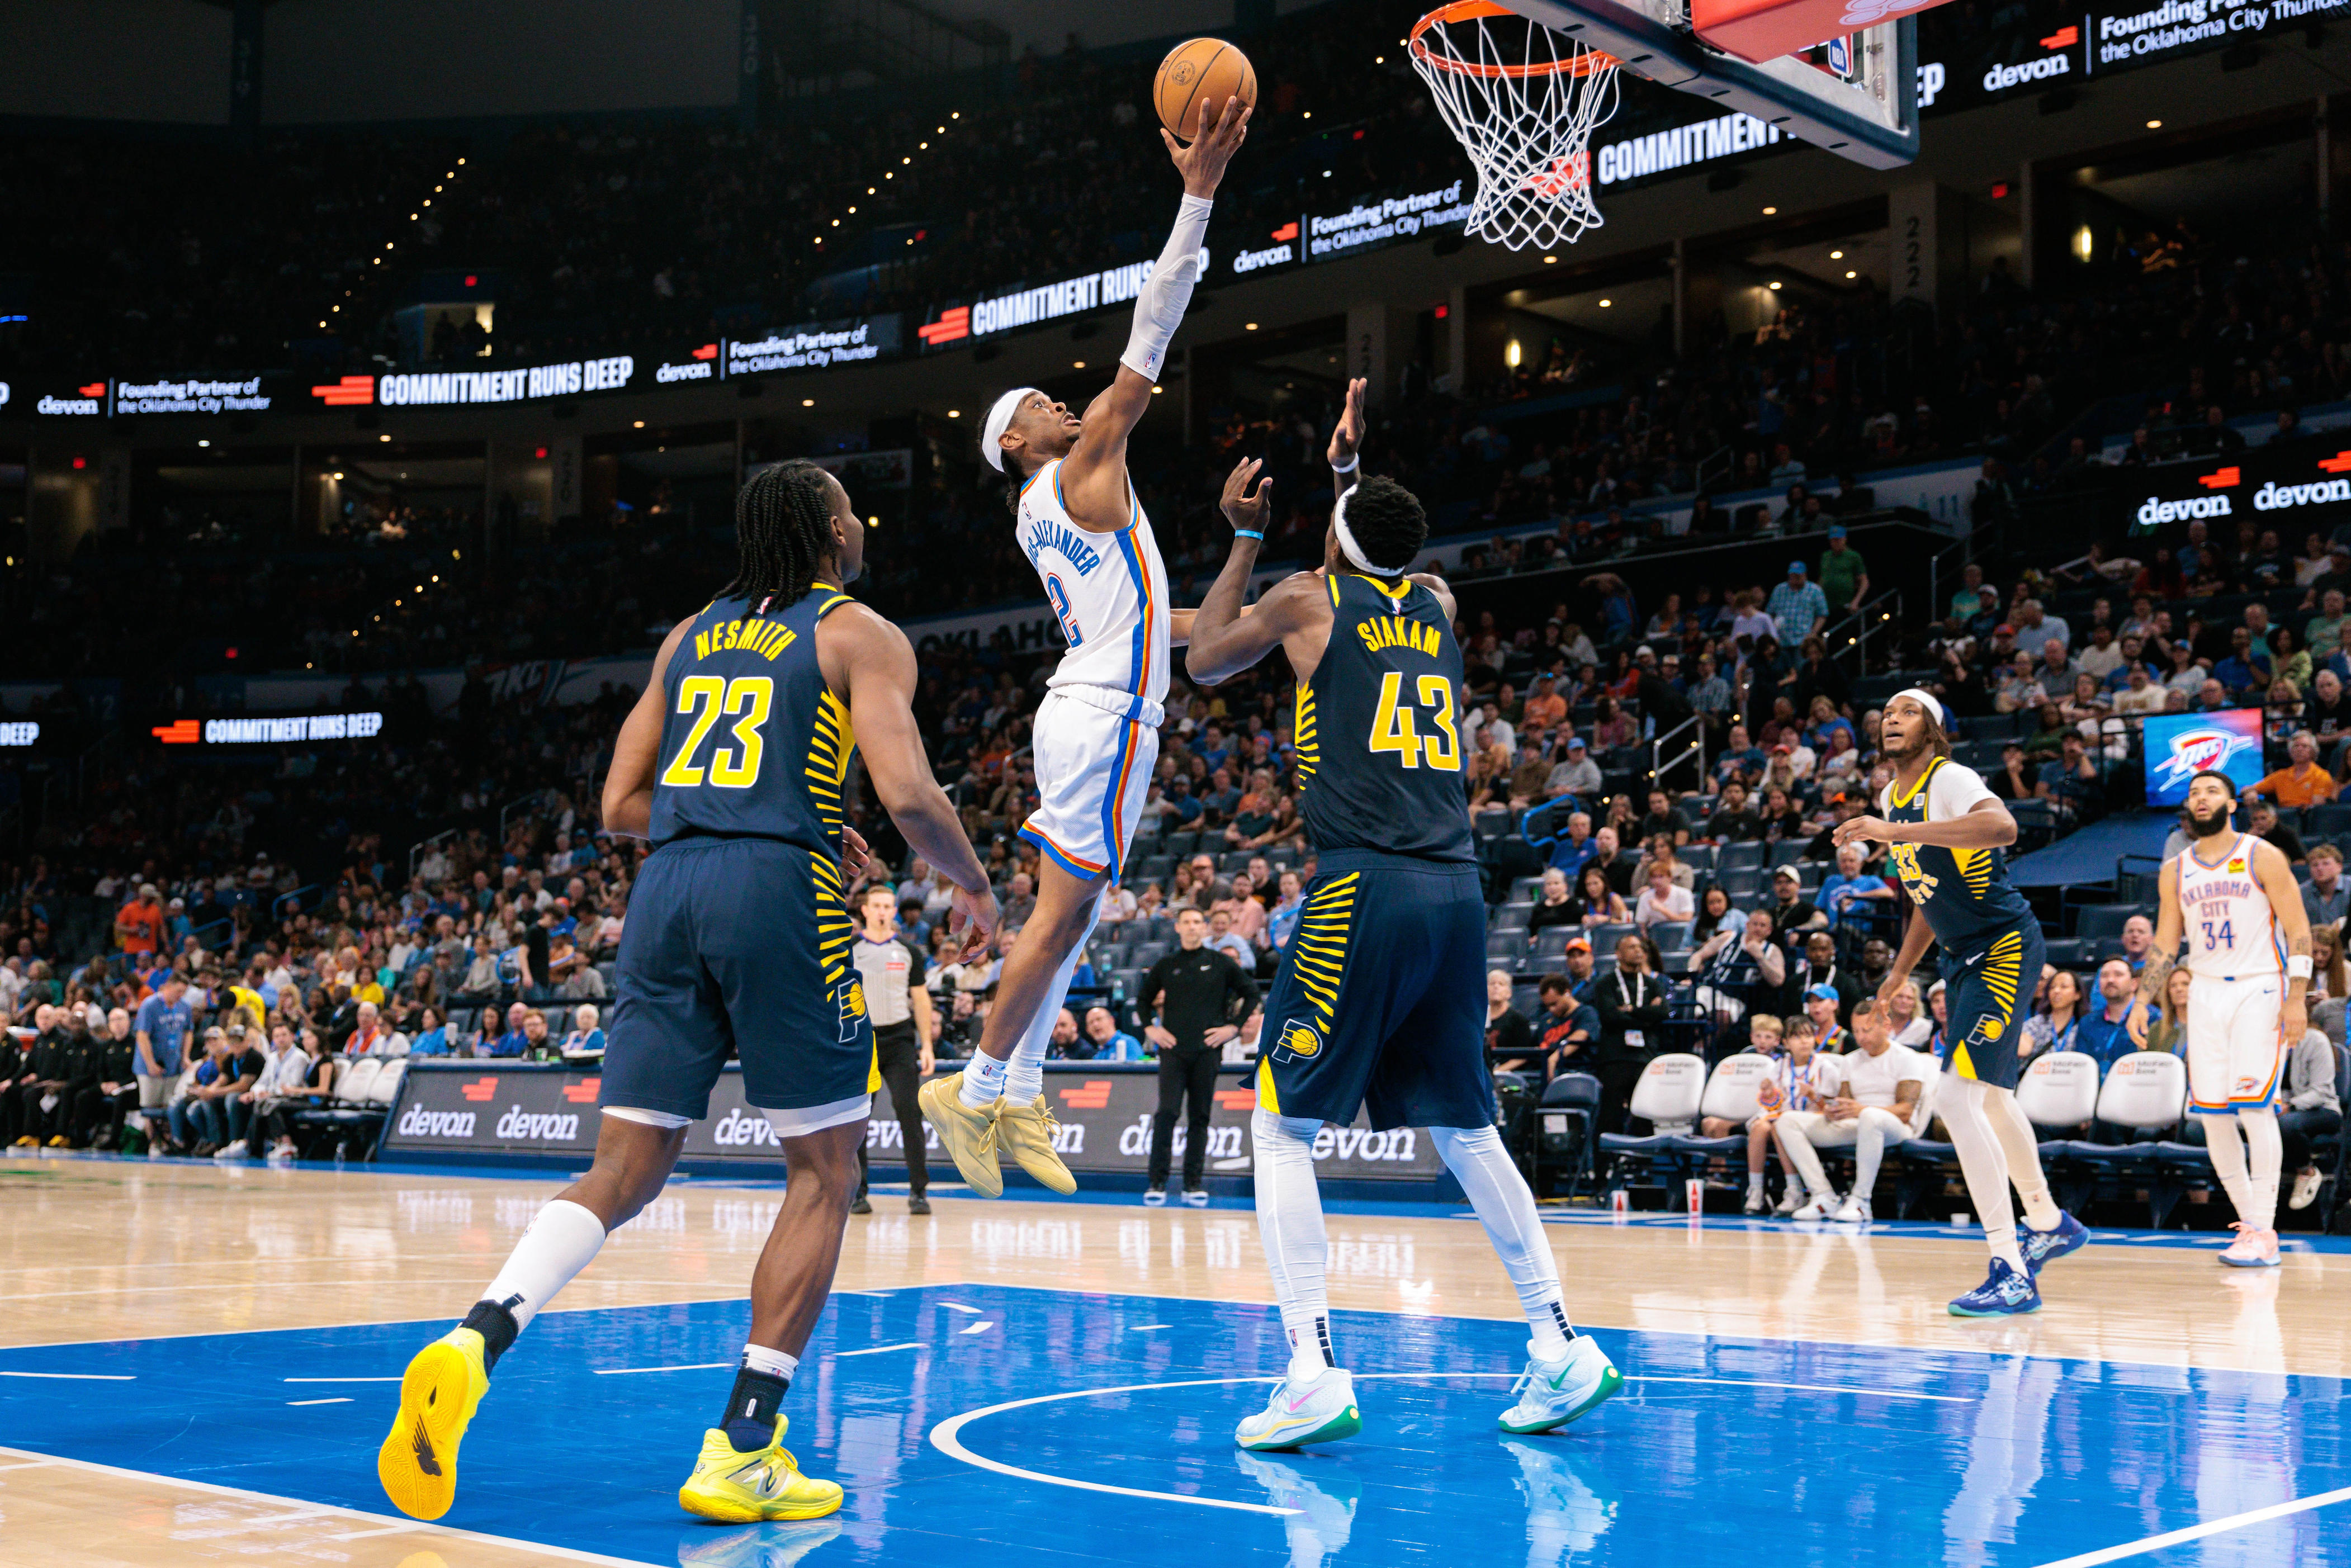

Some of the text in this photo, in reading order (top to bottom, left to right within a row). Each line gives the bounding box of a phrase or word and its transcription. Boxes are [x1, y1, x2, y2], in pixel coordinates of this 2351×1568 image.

[2099, 41, 2131, 63] the
[2132, 18, 2226, 54] Oklahoma
[2229, 7, 2269, 31] City
[2100, 0, 2208, 40] Founding
[1832, 46, 1844, 67] NBA
[1984, 53, 2070, 92] devon
[1311, 179, 1463, 236] Founding Partner of
[1311, 236, 1332, 255] the
[1332, 221, 1394, 250] Oklahoma
[1395, 214, 1421, 236] City
[1233, 244, 1293, 273] devon
[972, 273, 1101, 335] COMMITMENT
[730, 324, 869, 358] Founding Partner of
[656, 362, 712, 383] devon
[729, 345, 878, 375] the Oklahoma City Thunder
[119, 377, 261, 400] Founding Partner of
[380, 356, 633, 405] COMMITMENT RUNS DEEP
[37, 395, 99, 415] devon
[2137, 494, 2232, 525] devon
[2253, 479, 2351, 511] devon
[1047, 572, 1086, 648] 2
[695, 619, 797, 661] NESMITH
[1357, 616, 1441, 658] SIAKAM
[0, 722, 40, 746] DEEP
[205, 712, 383, 743] COMMITMENT RUNS DEEP
[661, 675, 774, 789] 23
[1369, 671, 1461, 772] 43
[1891, 842, 1923, 883] 33
[2182, 880, 2251, 907] OKLAHOMA
[2201, 899, 2230, 918] CITY
[2201, 919, 2238, 950] 34
[399, 1102, 476, 1138] devon
[496, 1104, 579, 1141] devon
[714, 1107, 781, 1147] dev
[1312, 1125, 1417, 1162] evon
